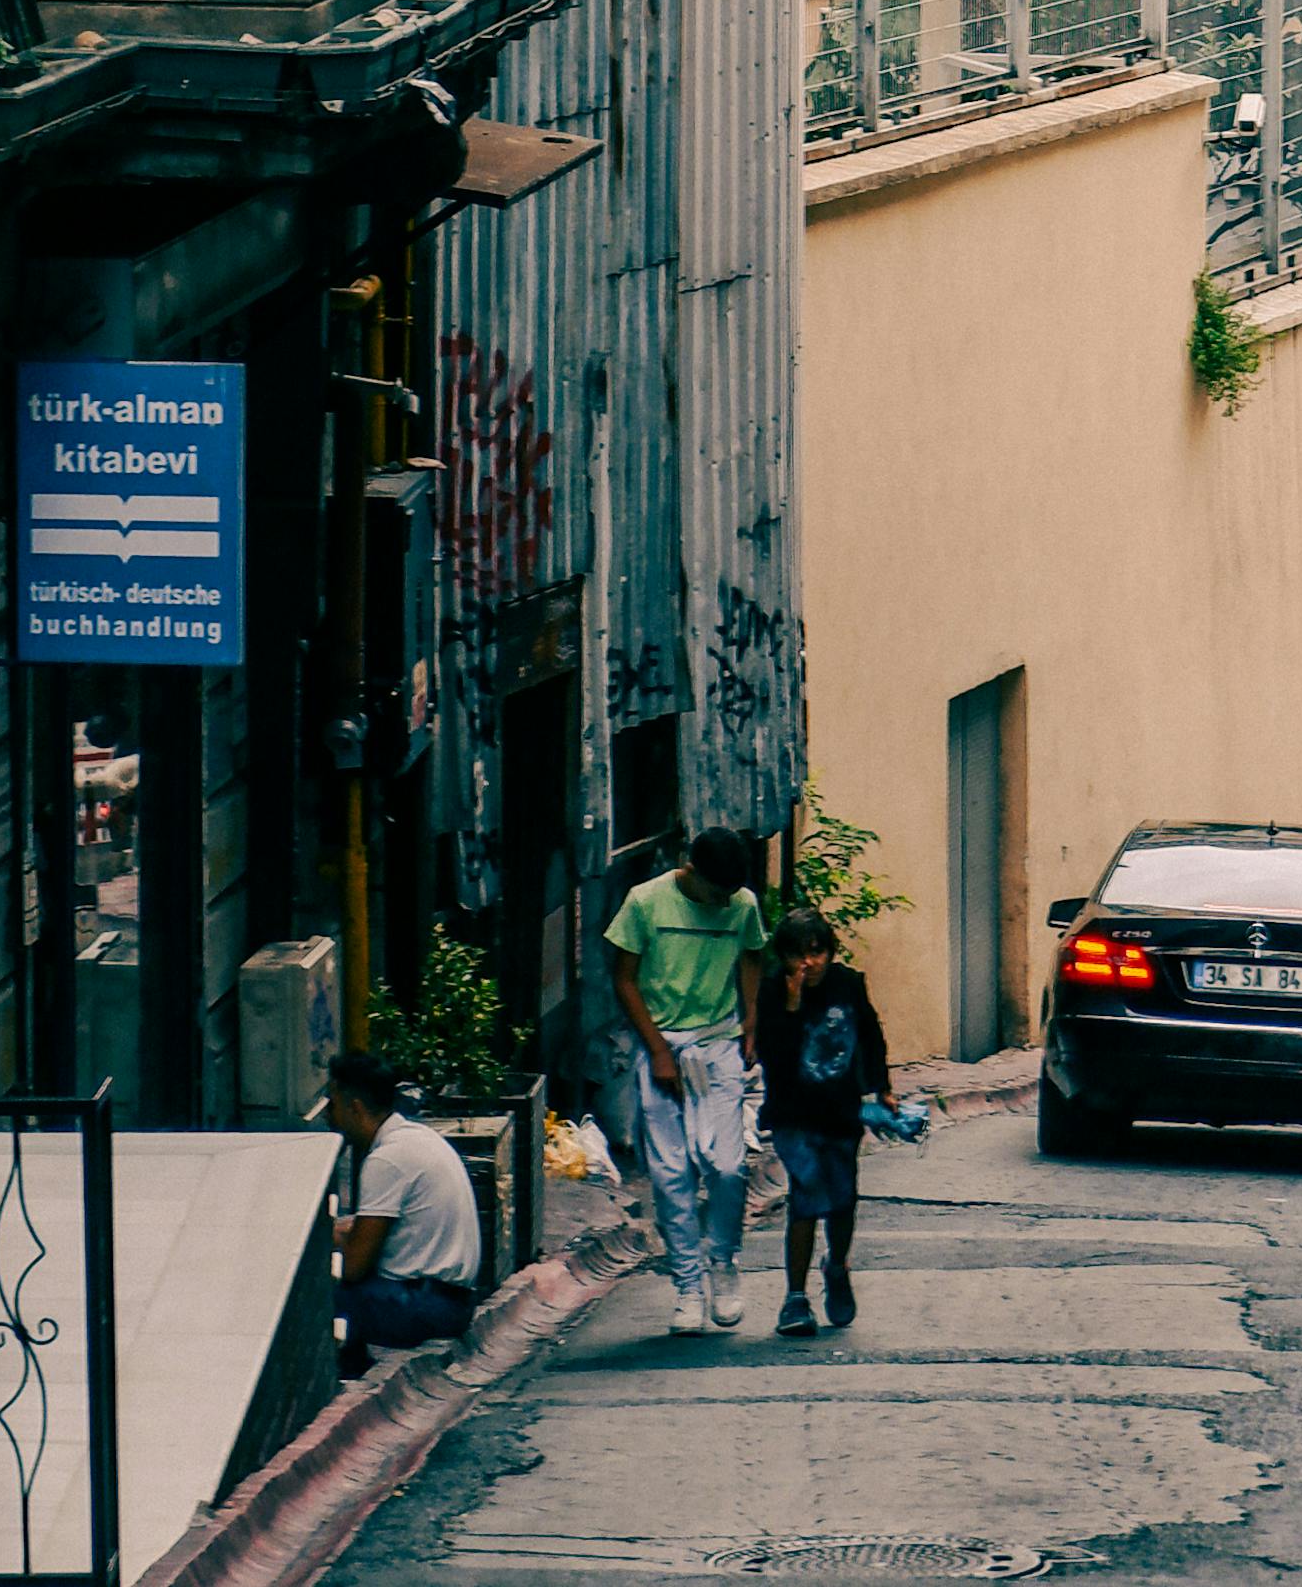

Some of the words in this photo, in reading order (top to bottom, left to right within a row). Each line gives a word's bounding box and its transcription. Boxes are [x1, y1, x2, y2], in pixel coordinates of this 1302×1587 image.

[28, 393, 224, 426] türk-alman
[54, 443, 198, 475] kitabevi
[126, 582, 221, 606] deutsche
[29, 613, 222, 644] buchhandlung
[1205, 965, 1227, 985] 34
